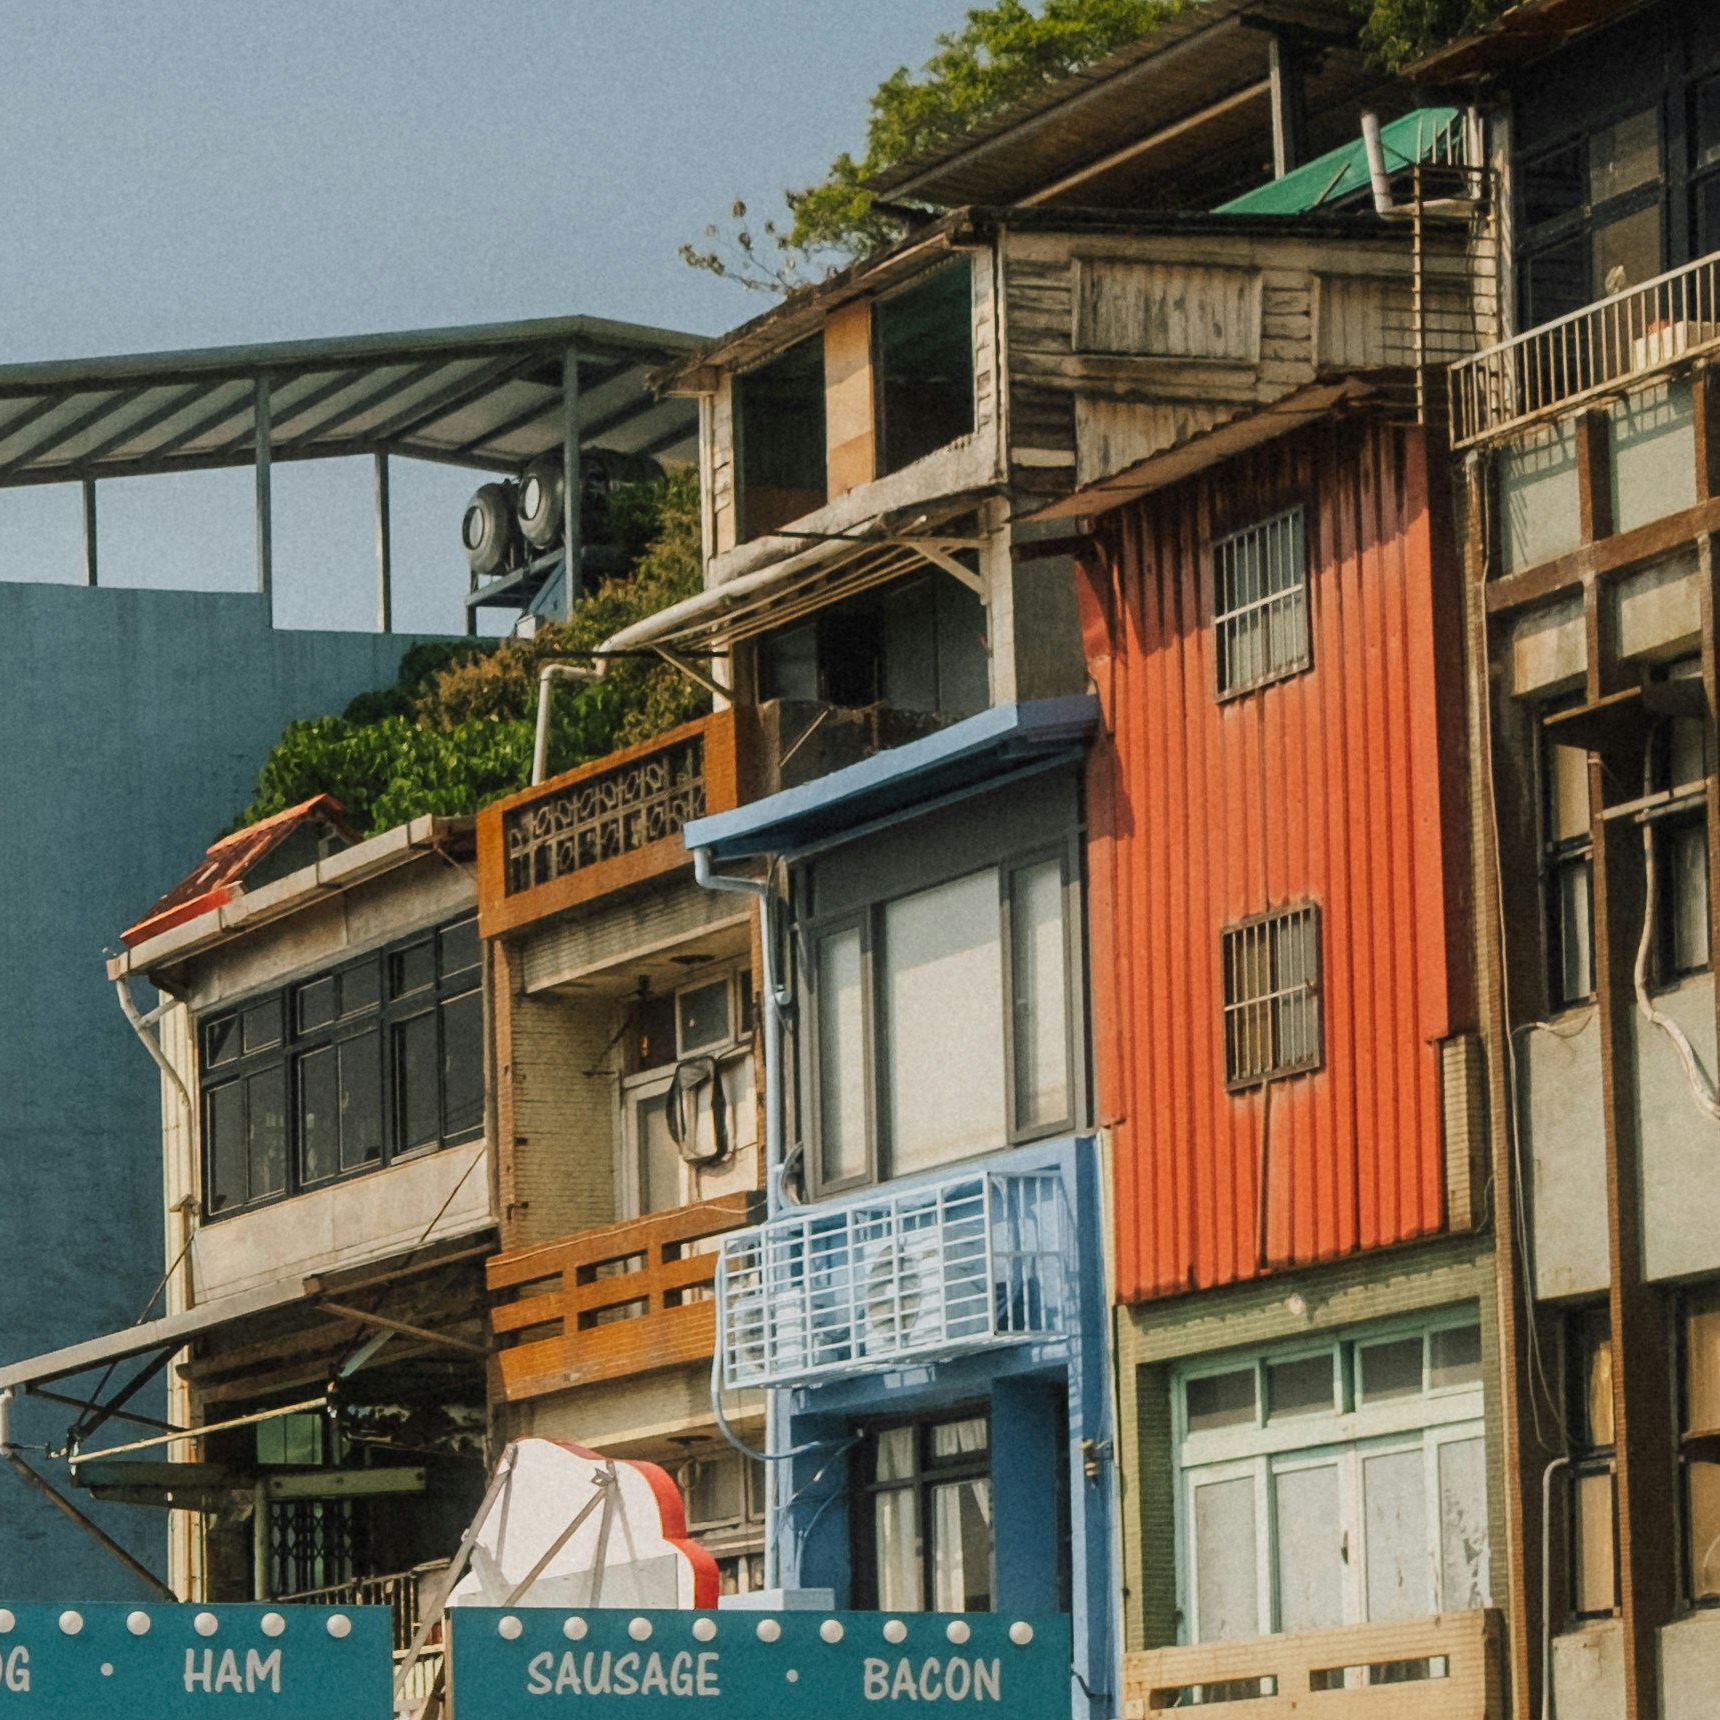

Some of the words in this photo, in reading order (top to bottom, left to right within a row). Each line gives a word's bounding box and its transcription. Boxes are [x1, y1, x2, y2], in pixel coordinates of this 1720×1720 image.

[183, 1646, 283, 1695] HAM
[526, 1650, 722, 1699] SAUSAGE
[862, 1655, 1003, 1702] BACON
